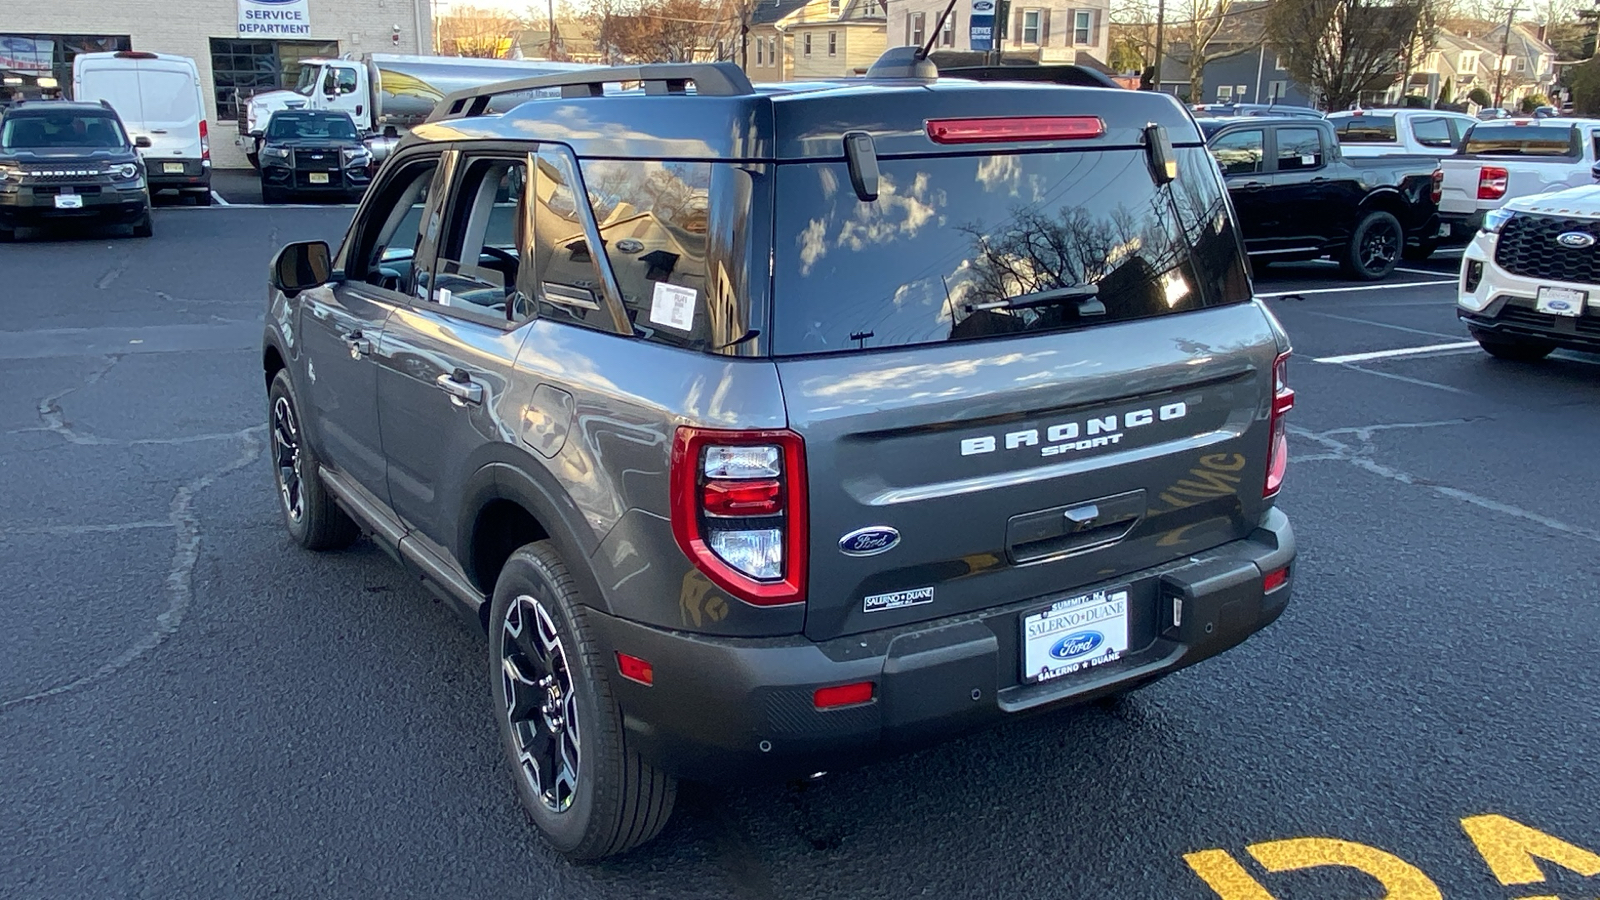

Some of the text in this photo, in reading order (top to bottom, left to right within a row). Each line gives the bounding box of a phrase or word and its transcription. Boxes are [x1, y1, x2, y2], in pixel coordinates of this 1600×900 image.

[245, 10, 302, 20] SERVICE
[239, 23, 310, 34] DEPARTMENT
[960, 402, 1187, 456] BRONCO
[1041, 433, 1123, 457] SPORT
[866, 594, 901, 607] SALERNO
[906, 588, 932, 600] DUANE
[1052, 590, 1105, 611] SUMMIT, NJ
[1028, 601, 1124, 637] SALERNO DUANE
[1038, 652, 1121, 682] SALERNO DUANE
